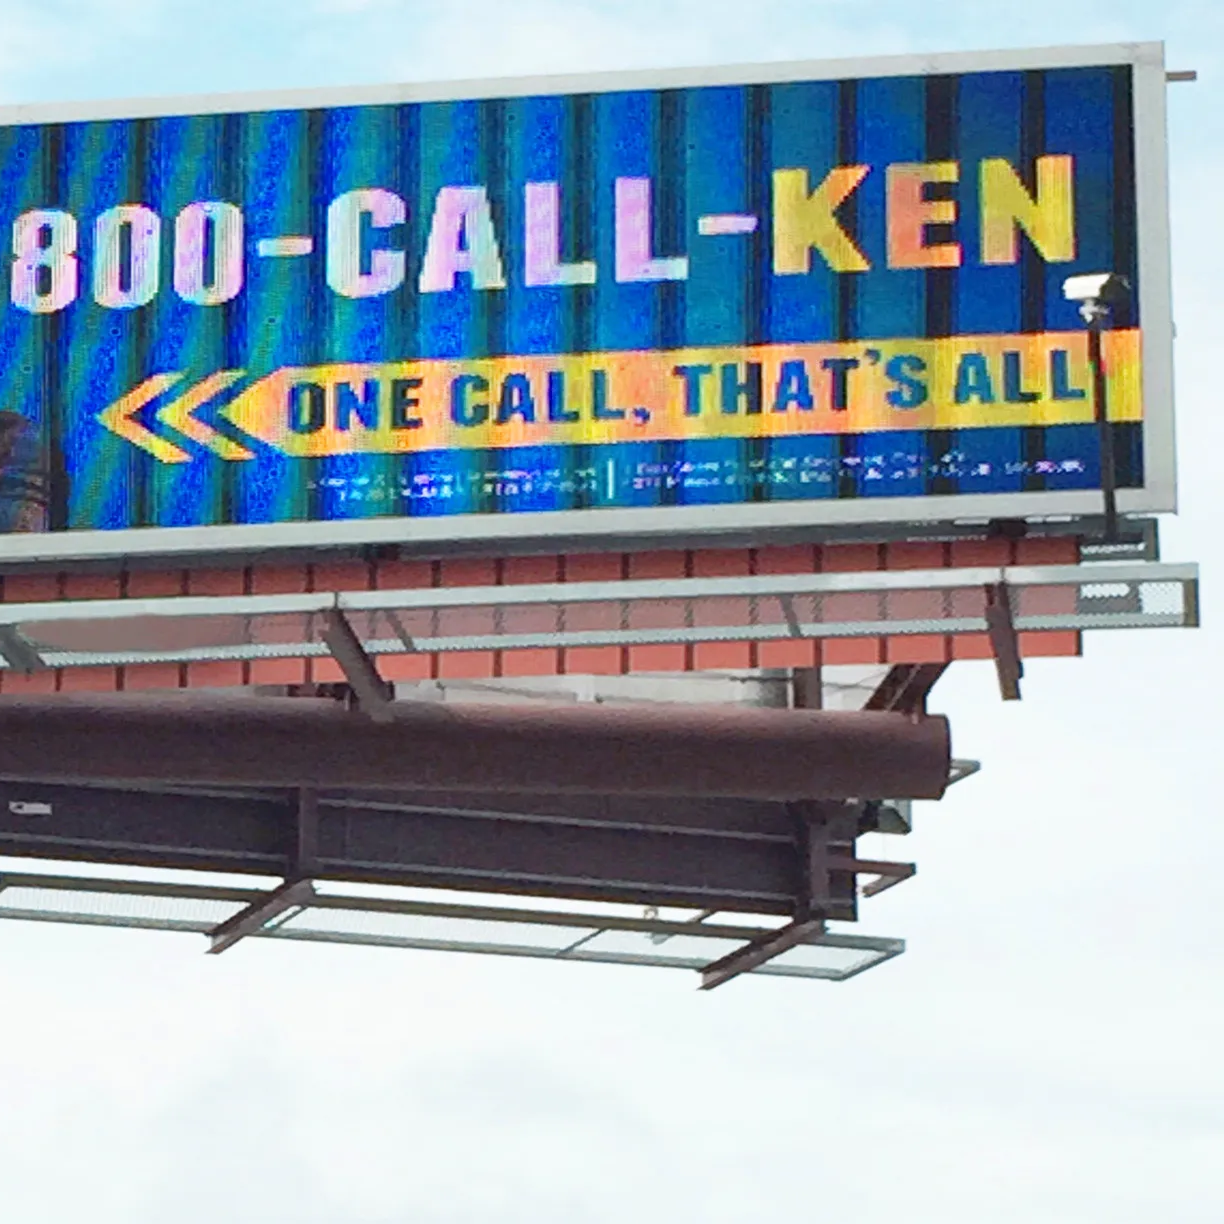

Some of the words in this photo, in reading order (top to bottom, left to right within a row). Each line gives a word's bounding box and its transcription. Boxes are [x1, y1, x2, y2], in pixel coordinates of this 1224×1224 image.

[286, 377, 424, 434] ONE
[450, 366, 652, 426] CALL,
[673, 348, 927, 418] THAT'S
[955, 349, 1086, 403] ALL
